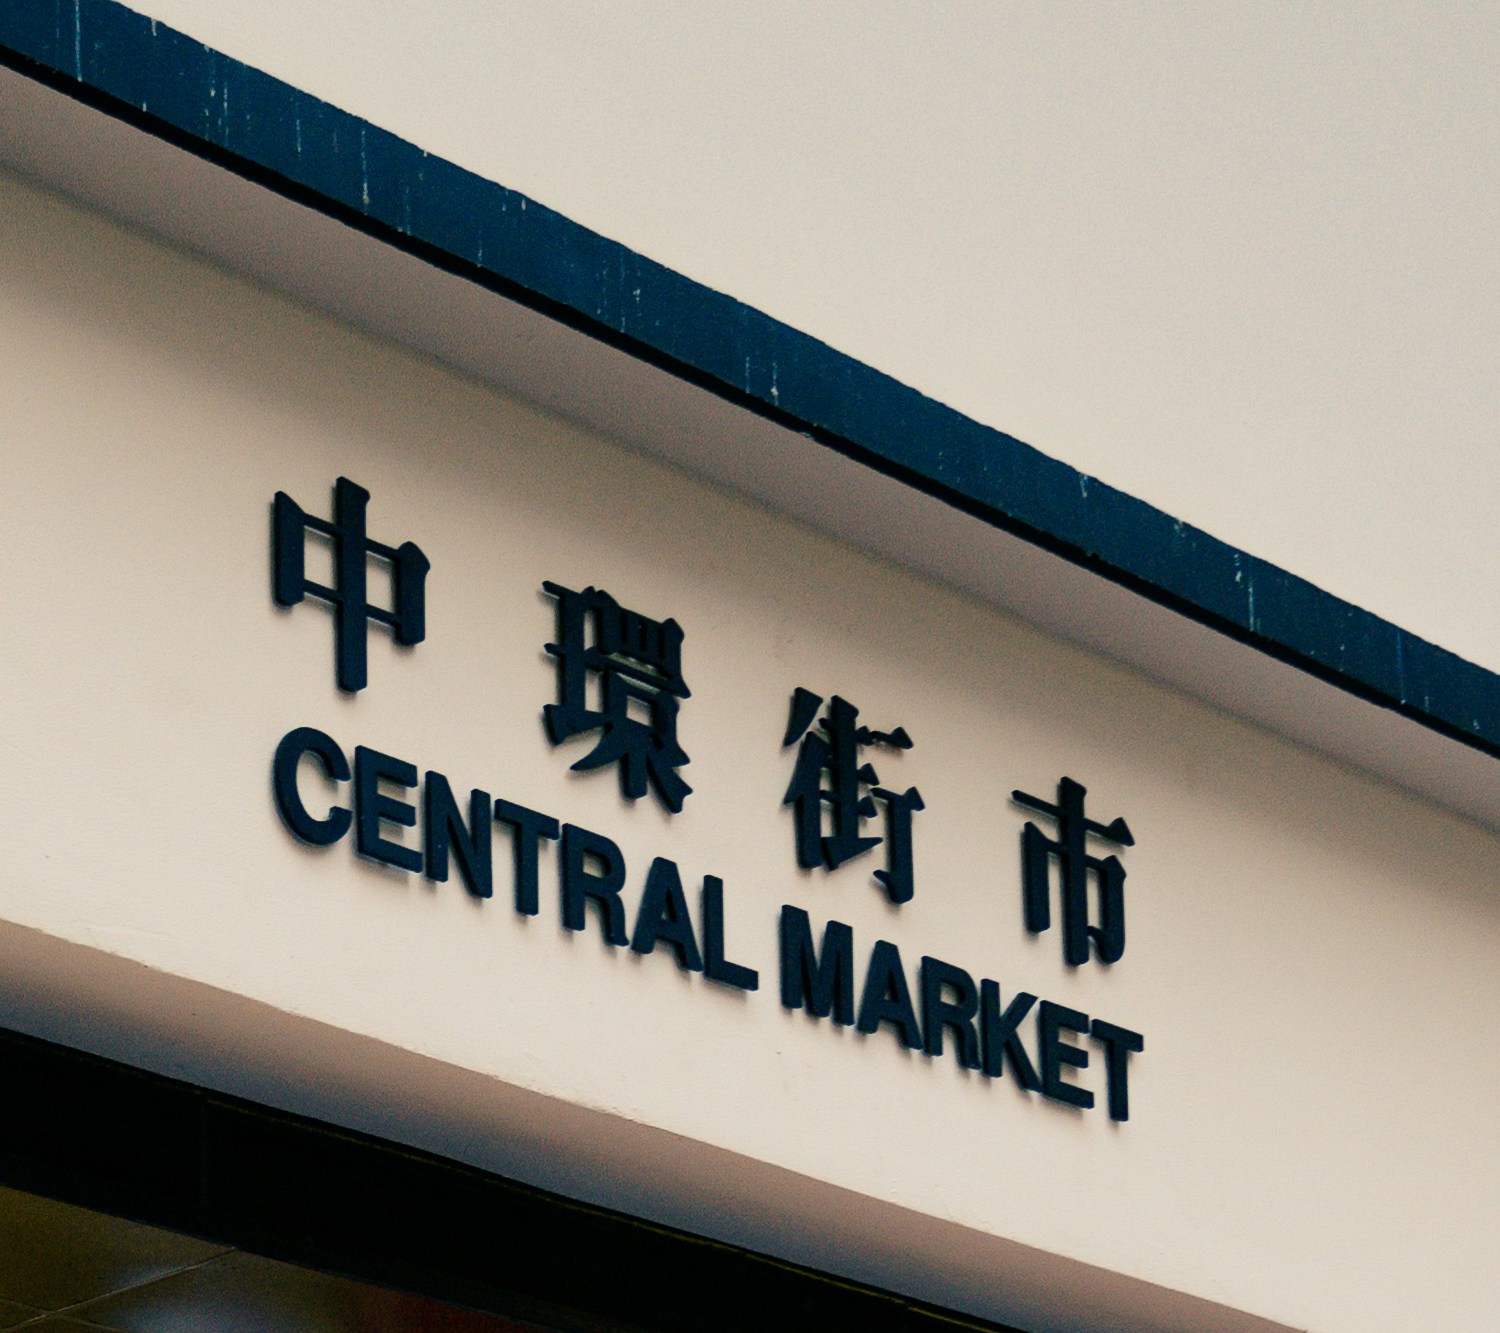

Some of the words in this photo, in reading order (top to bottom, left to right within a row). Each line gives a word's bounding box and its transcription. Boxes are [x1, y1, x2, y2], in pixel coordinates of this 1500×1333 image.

[271, 476, 1135, 968] 中環街市
[273, 726, 758, 993] CENTRAL
[780, 904, 1144, 1122] MARKET
